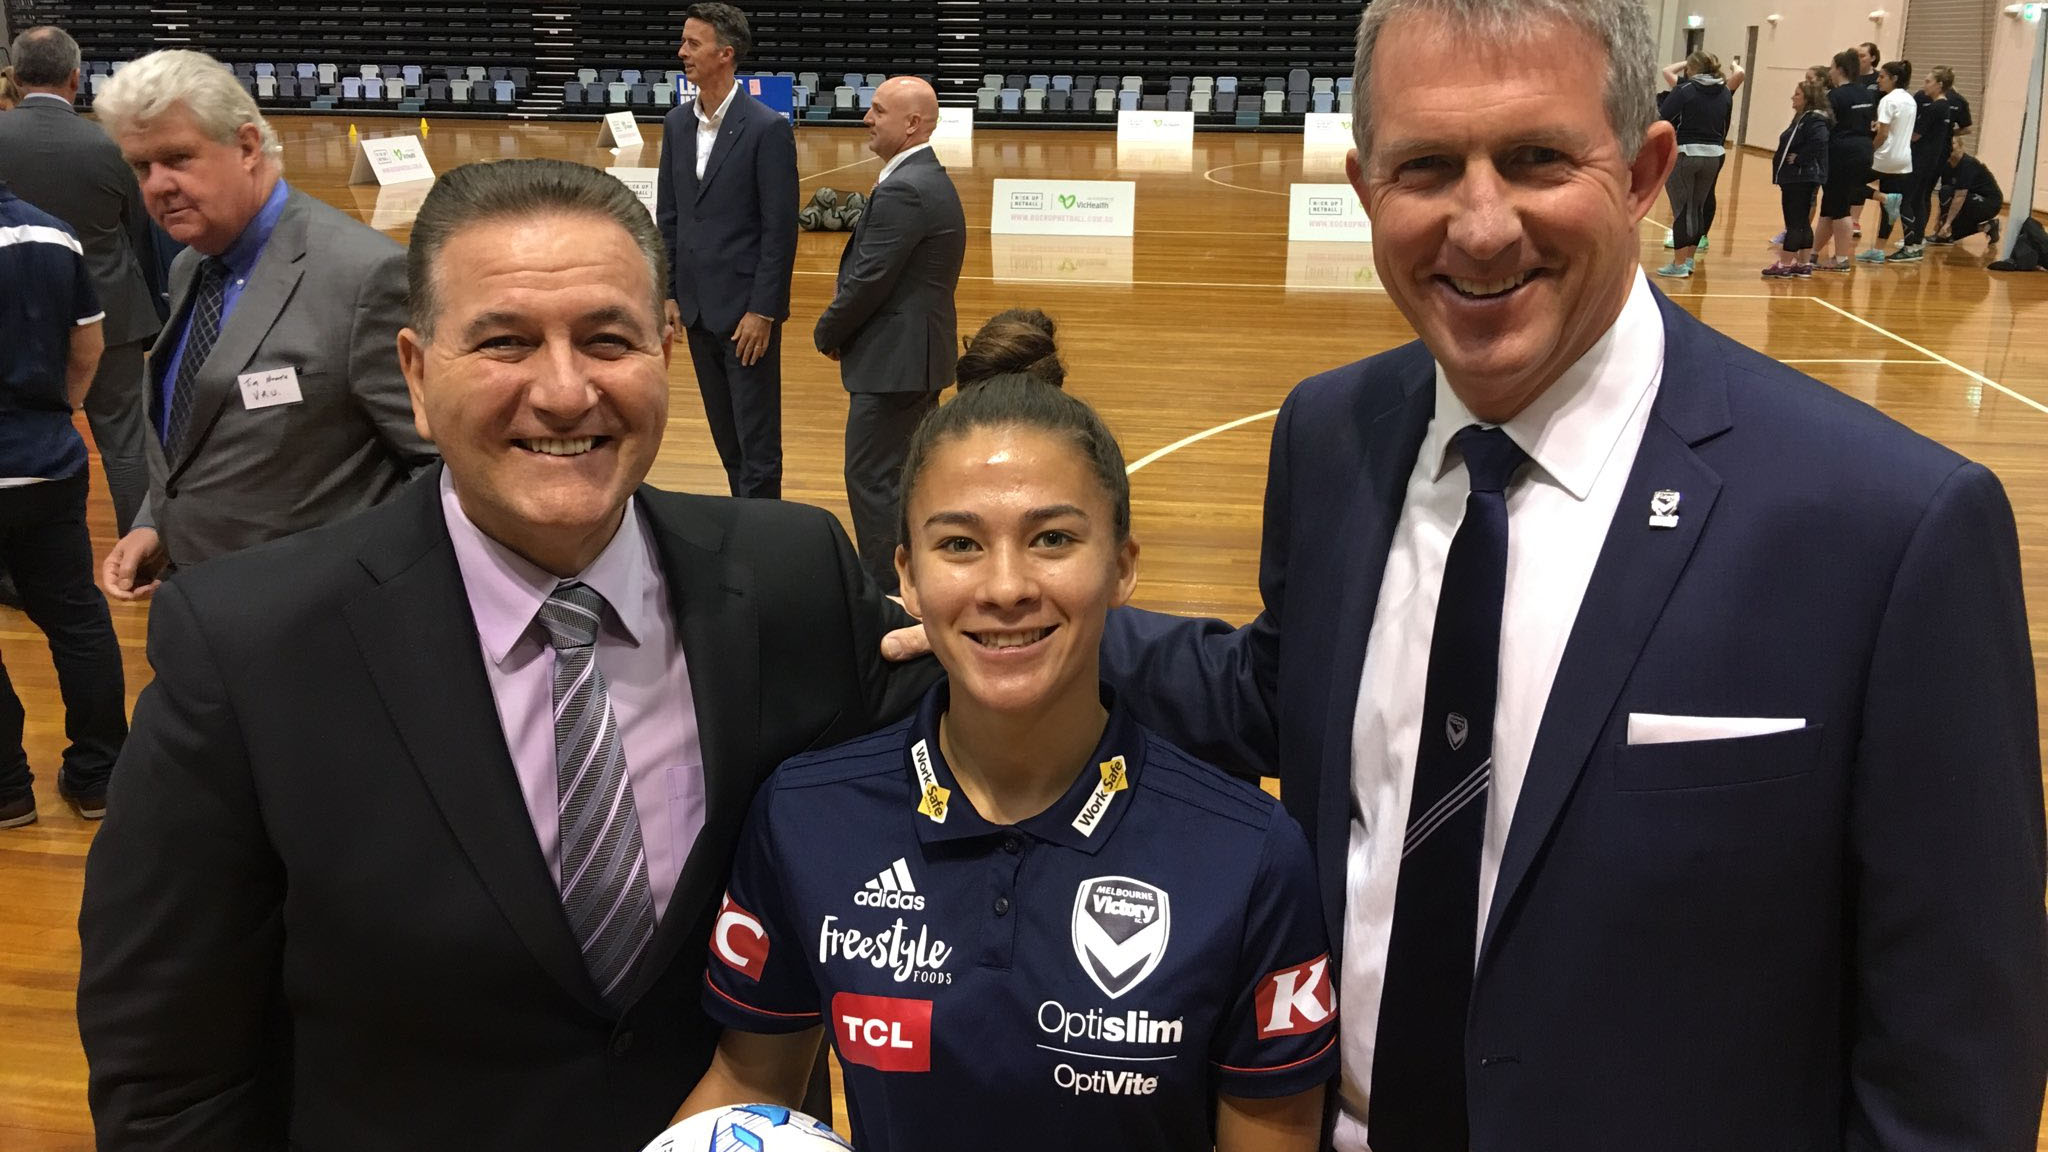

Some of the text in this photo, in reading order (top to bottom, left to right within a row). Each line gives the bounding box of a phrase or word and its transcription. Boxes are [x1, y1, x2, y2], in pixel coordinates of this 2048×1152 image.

[1076, 201, 1109, 209] VicHealth
[916, 746, 933, 786] Work
[927, 785, 944, 817] Safe
[1078, 760, 1123, 827] Work Safe
[853, 888, 926, 911] adidas
[1092, 894, 1156, 924] Victory
[1096, 885, 1155, 901] MELBOURNE
[819, 914, 953, 982] Freestyle
[913, 970, 953, 985] FOODS
[842, 1014, 914, 1049] TCL
[1037, 1000, 1184, 1044] Optislim
[1054, 1063, 1159, 1096] OptiVite
